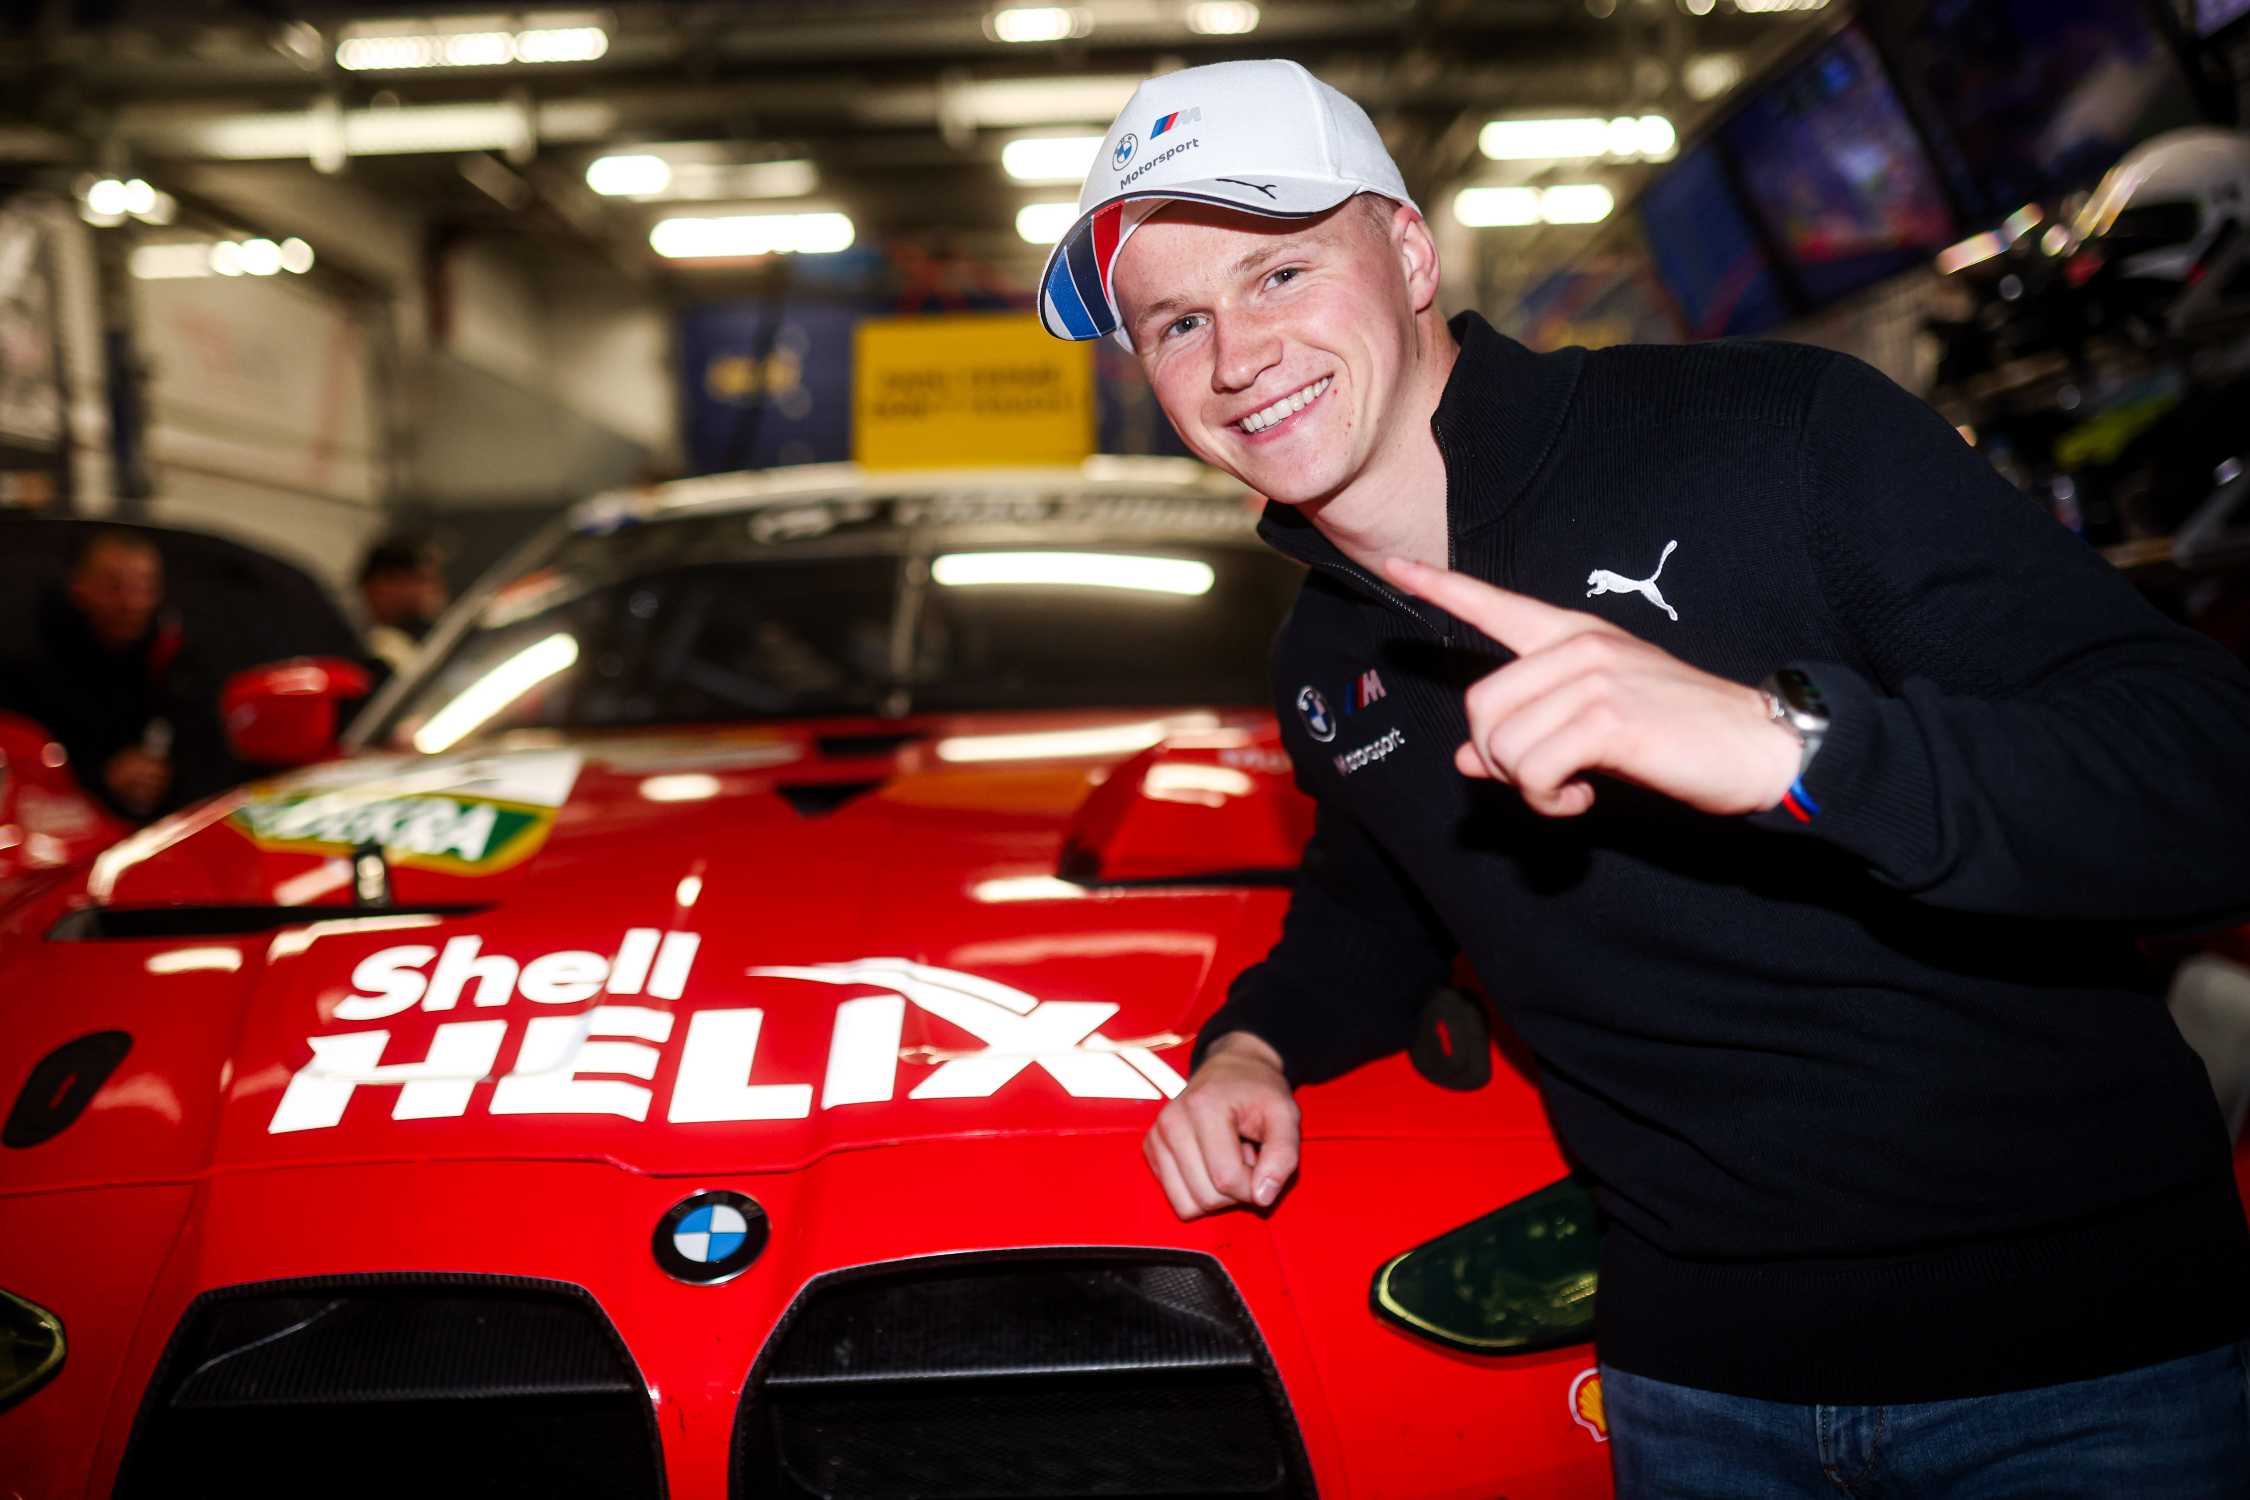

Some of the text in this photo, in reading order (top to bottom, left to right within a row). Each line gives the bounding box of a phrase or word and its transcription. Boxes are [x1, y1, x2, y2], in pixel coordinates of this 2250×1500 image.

[1119, 138, 1199, 190] Motorsport
[1333, 727, 1405, 776] Motorsport
[332, 927, 701, 1021] Shell
[267, 956, 1187, 1135] HELIX
